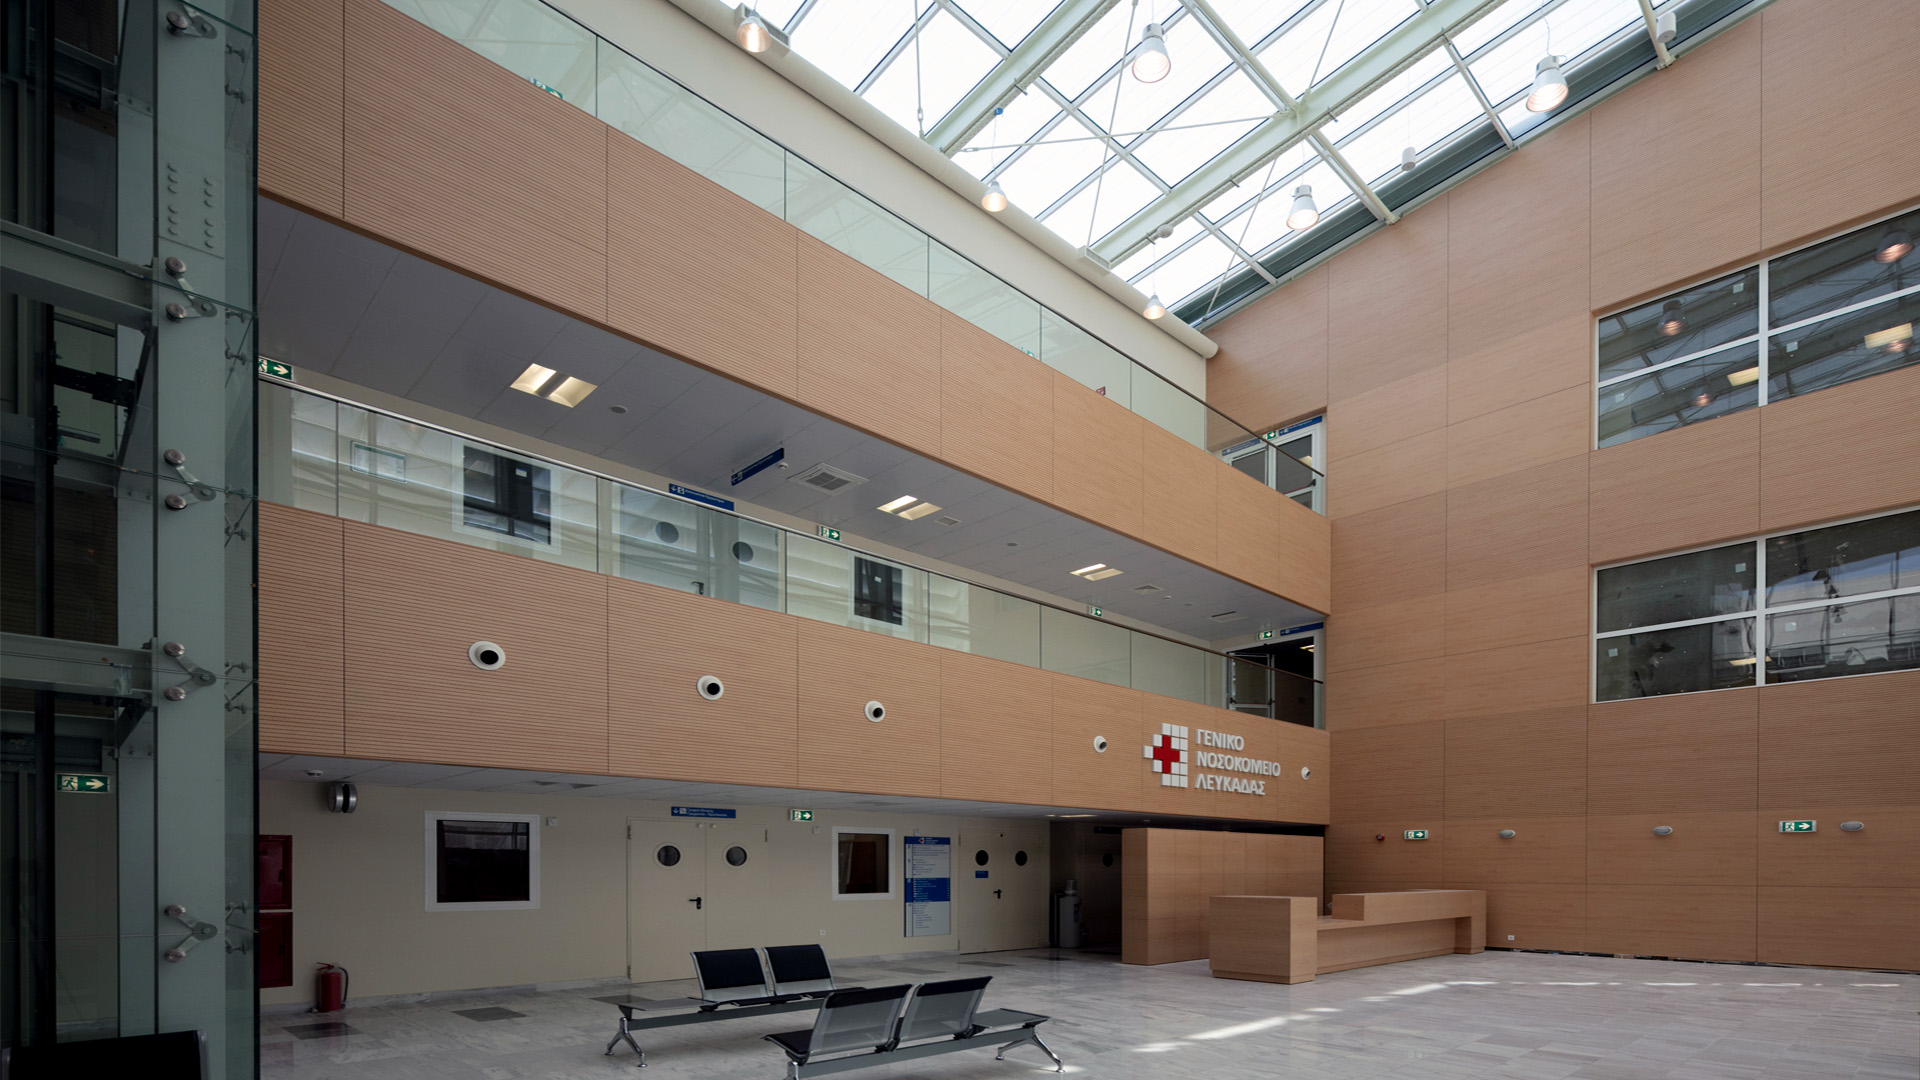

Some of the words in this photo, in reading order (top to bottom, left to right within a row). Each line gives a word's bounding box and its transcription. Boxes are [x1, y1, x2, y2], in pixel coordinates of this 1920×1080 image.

[1196, 729, 1244, 751] ΓΕΝΙΚΟ
[1196, 751, 1281, 777] ΝΟΣΟΚΟΜΕΙΟ
[1195, 774, 1266, 795] ΛΕΥΚΑΔΑΣ
